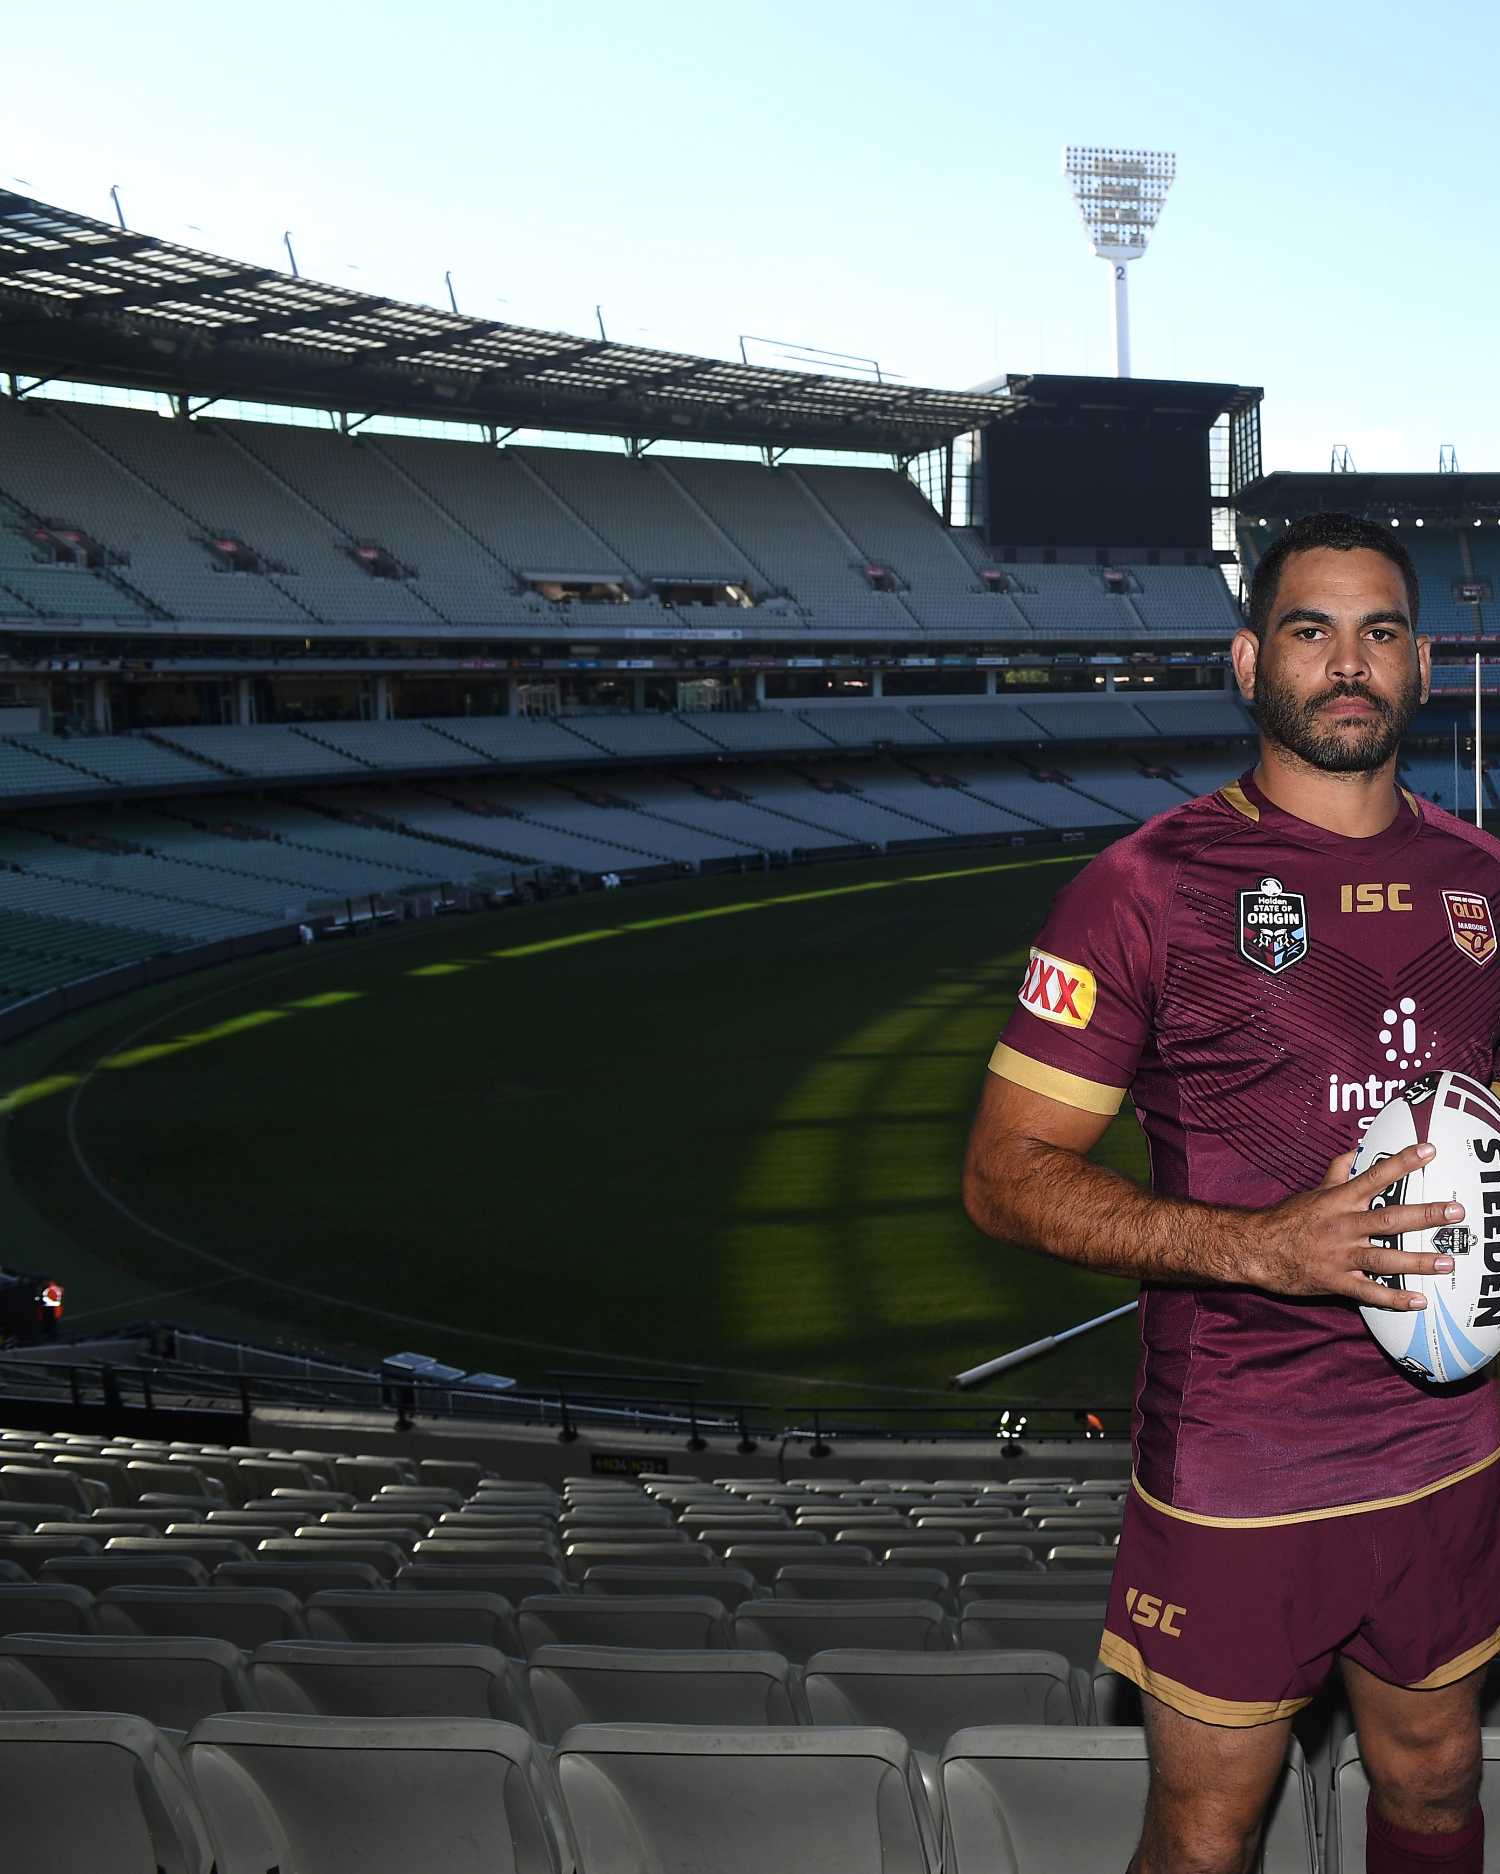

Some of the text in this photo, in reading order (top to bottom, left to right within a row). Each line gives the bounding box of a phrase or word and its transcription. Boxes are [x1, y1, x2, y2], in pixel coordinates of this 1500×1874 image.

[1115, 265, 1126, 281] 2
[1340, 883, 1413, 913] ISC
[1253, 904, 1293, 913] STATE OF
[1452, 902, 1485, 920] QLD
[1247, 912, 1300, 925] ORIGIN
[1329, 1073, 1406, 1113] intr
[1125, 1586, 1188, 1639] ISC
